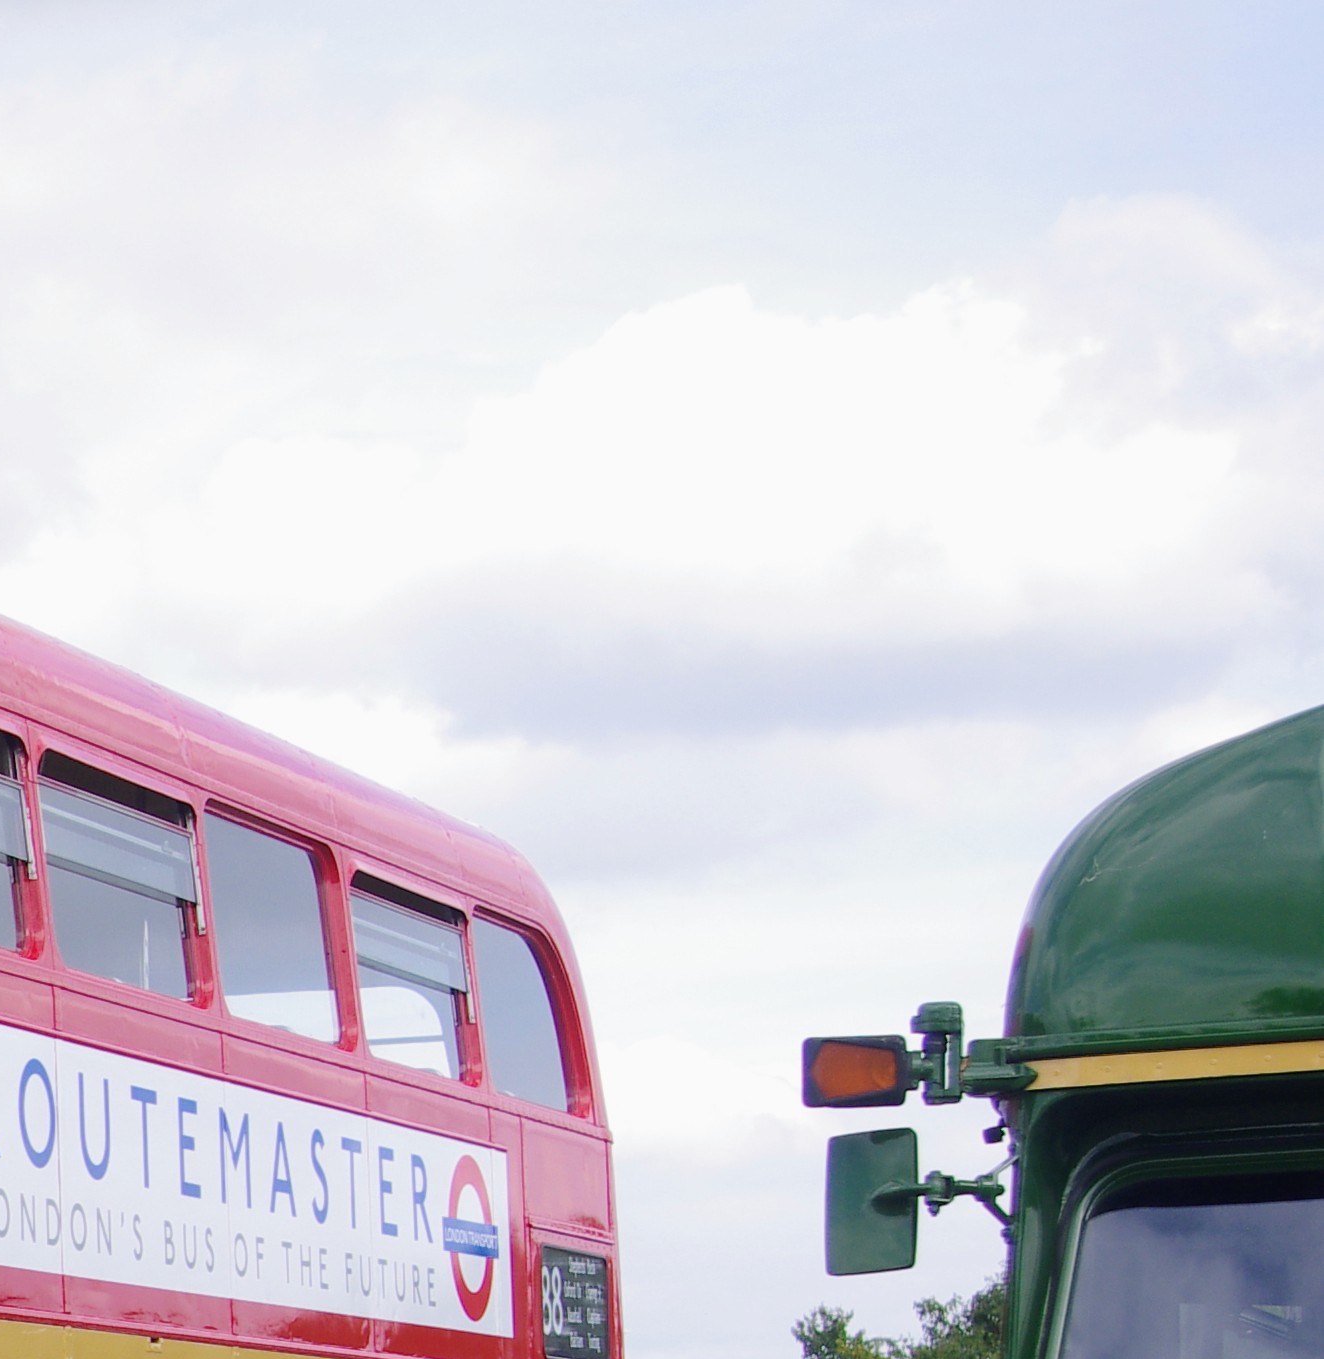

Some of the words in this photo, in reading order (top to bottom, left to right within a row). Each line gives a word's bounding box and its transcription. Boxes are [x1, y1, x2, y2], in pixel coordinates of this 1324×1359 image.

[164, 1219, 215, 1273] BUS
[233, 1232, 264, 1280] OF
[281, 1241, 330, 1290] THE
[344, 1252, 437, 1308] FUTURE
[542, 1266, 563, 1336] 88
